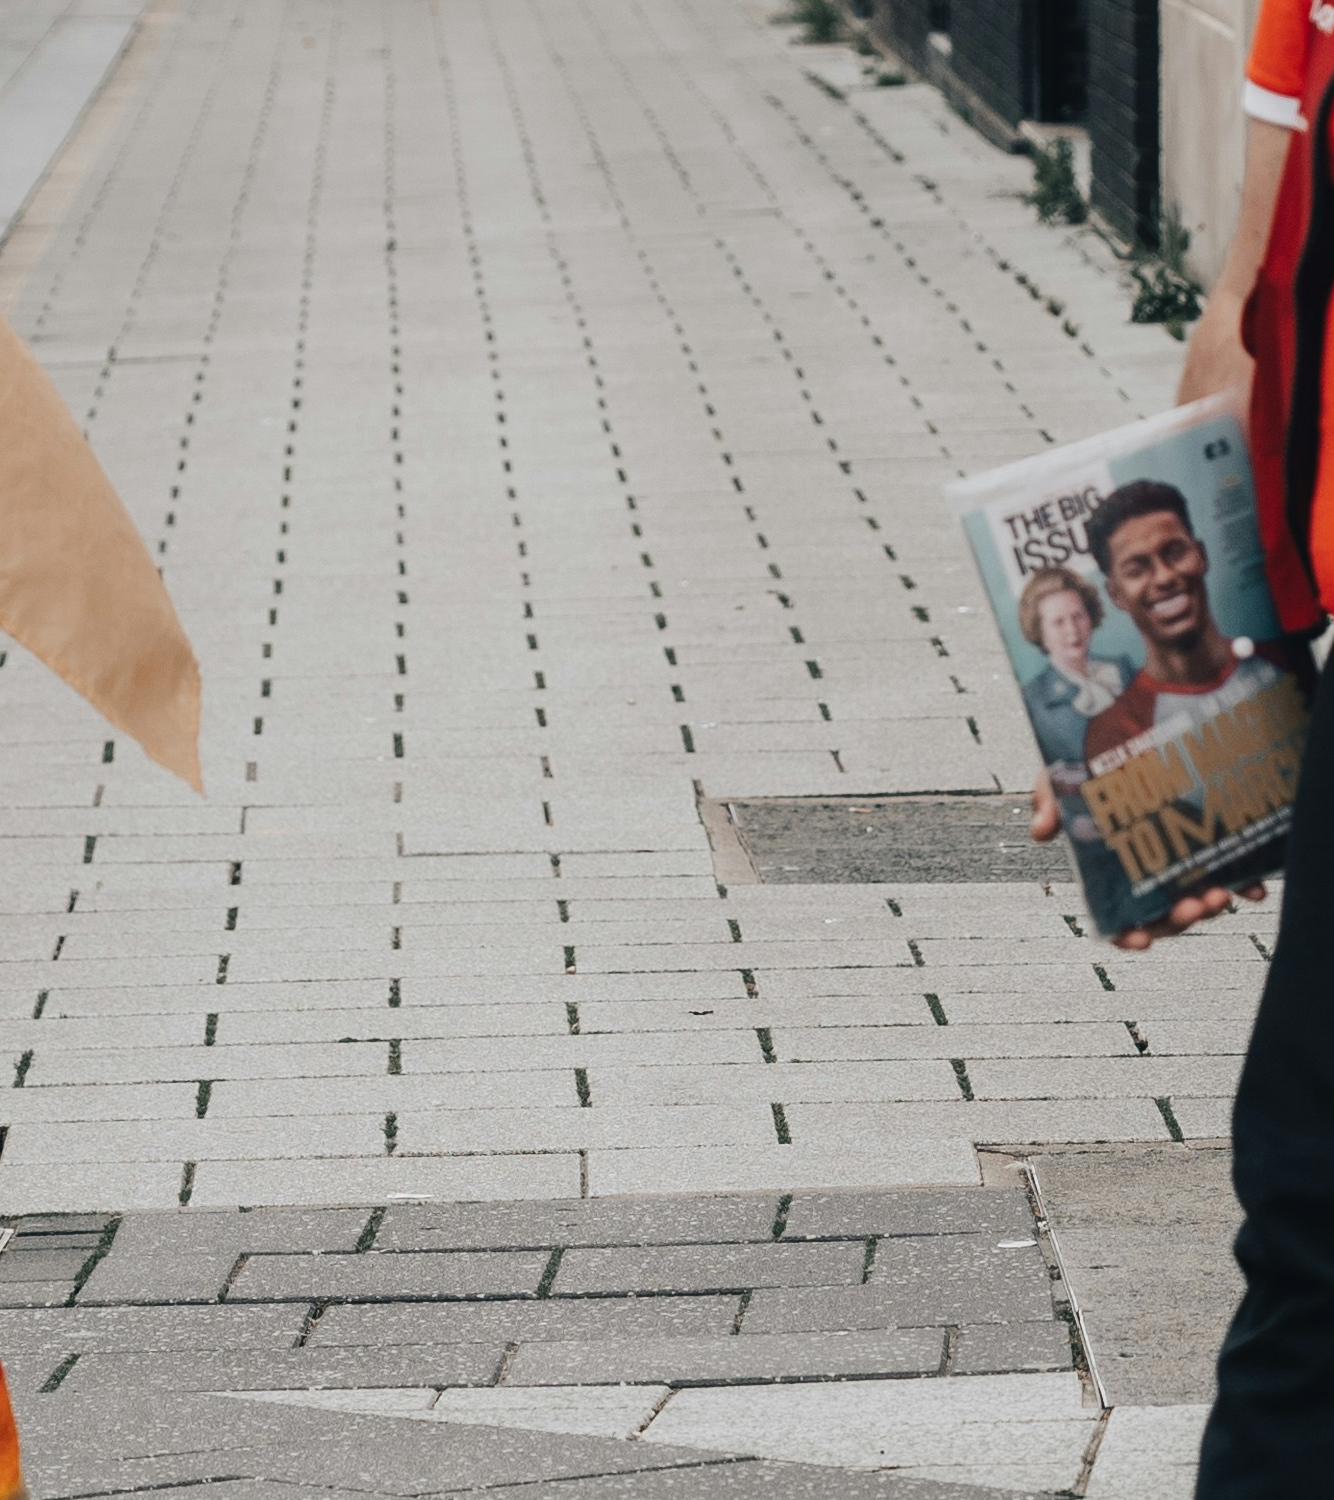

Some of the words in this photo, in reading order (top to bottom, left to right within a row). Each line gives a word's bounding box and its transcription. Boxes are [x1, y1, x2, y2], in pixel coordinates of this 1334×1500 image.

[1003, 502, 1056, 540] THE
[1057, 485, 1102, 521] BIG
[1013, 519, 1089, 576] ISSU
[1106, 815, 1169, 885] TO
